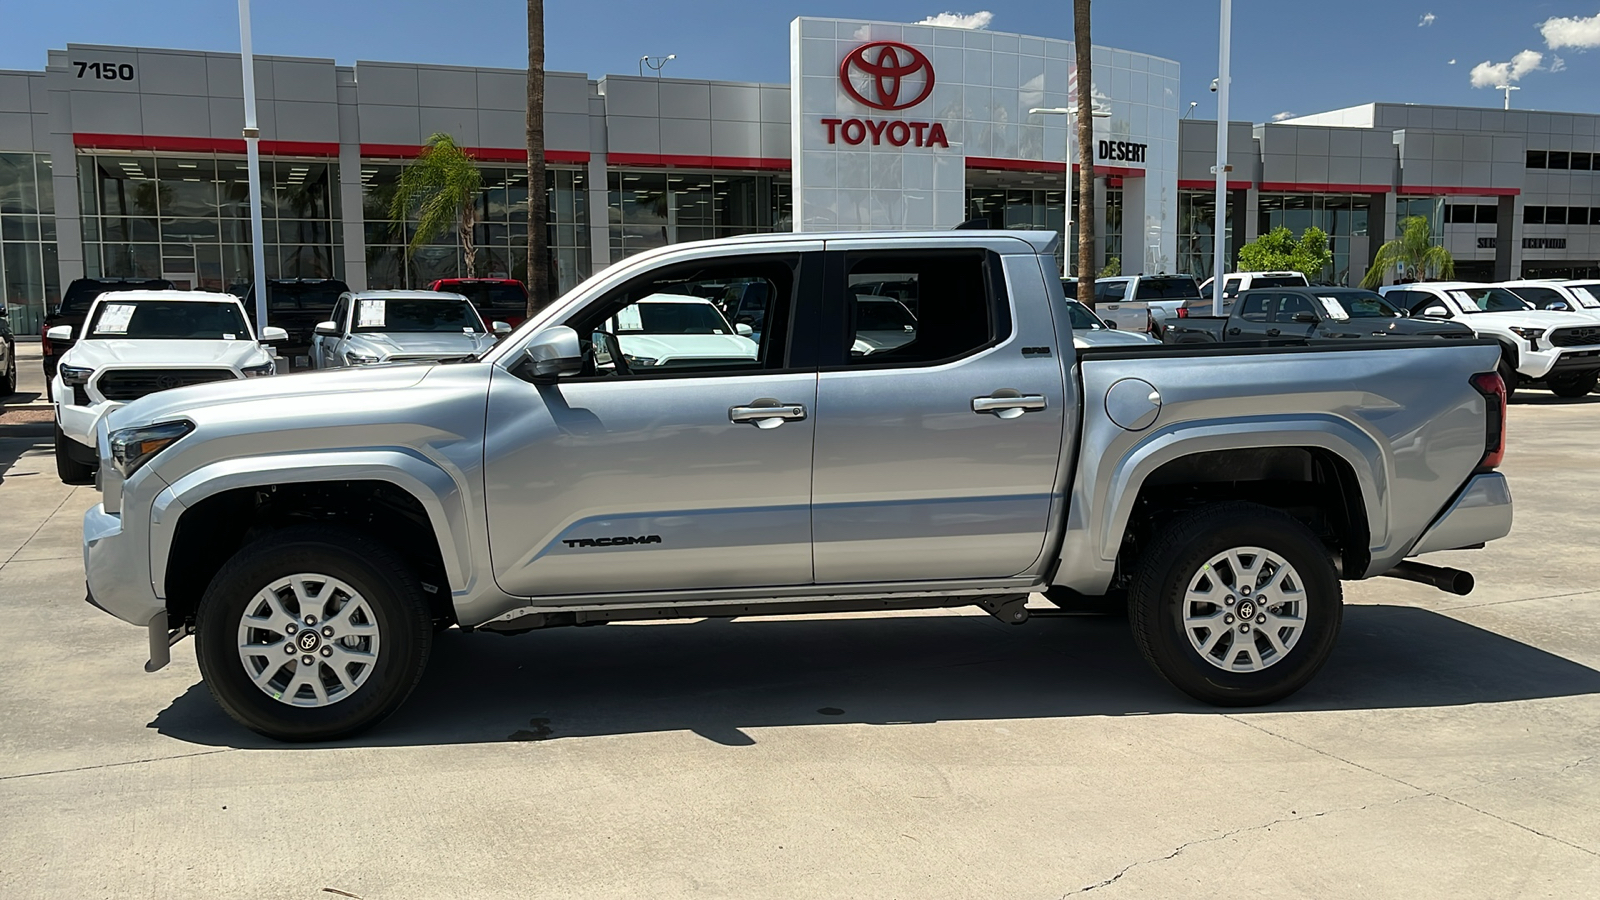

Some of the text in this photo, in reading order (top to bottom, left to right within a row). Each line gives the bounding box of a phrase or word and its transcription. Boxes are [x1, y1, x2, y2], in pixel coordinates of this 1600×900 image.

[73, 61, 134, 81] 7150
[821, 118, 949, 148] TOYOTA
[1099, 140, 1148, 163] DESERT
[562, 535, 662, 548] TACOMA
